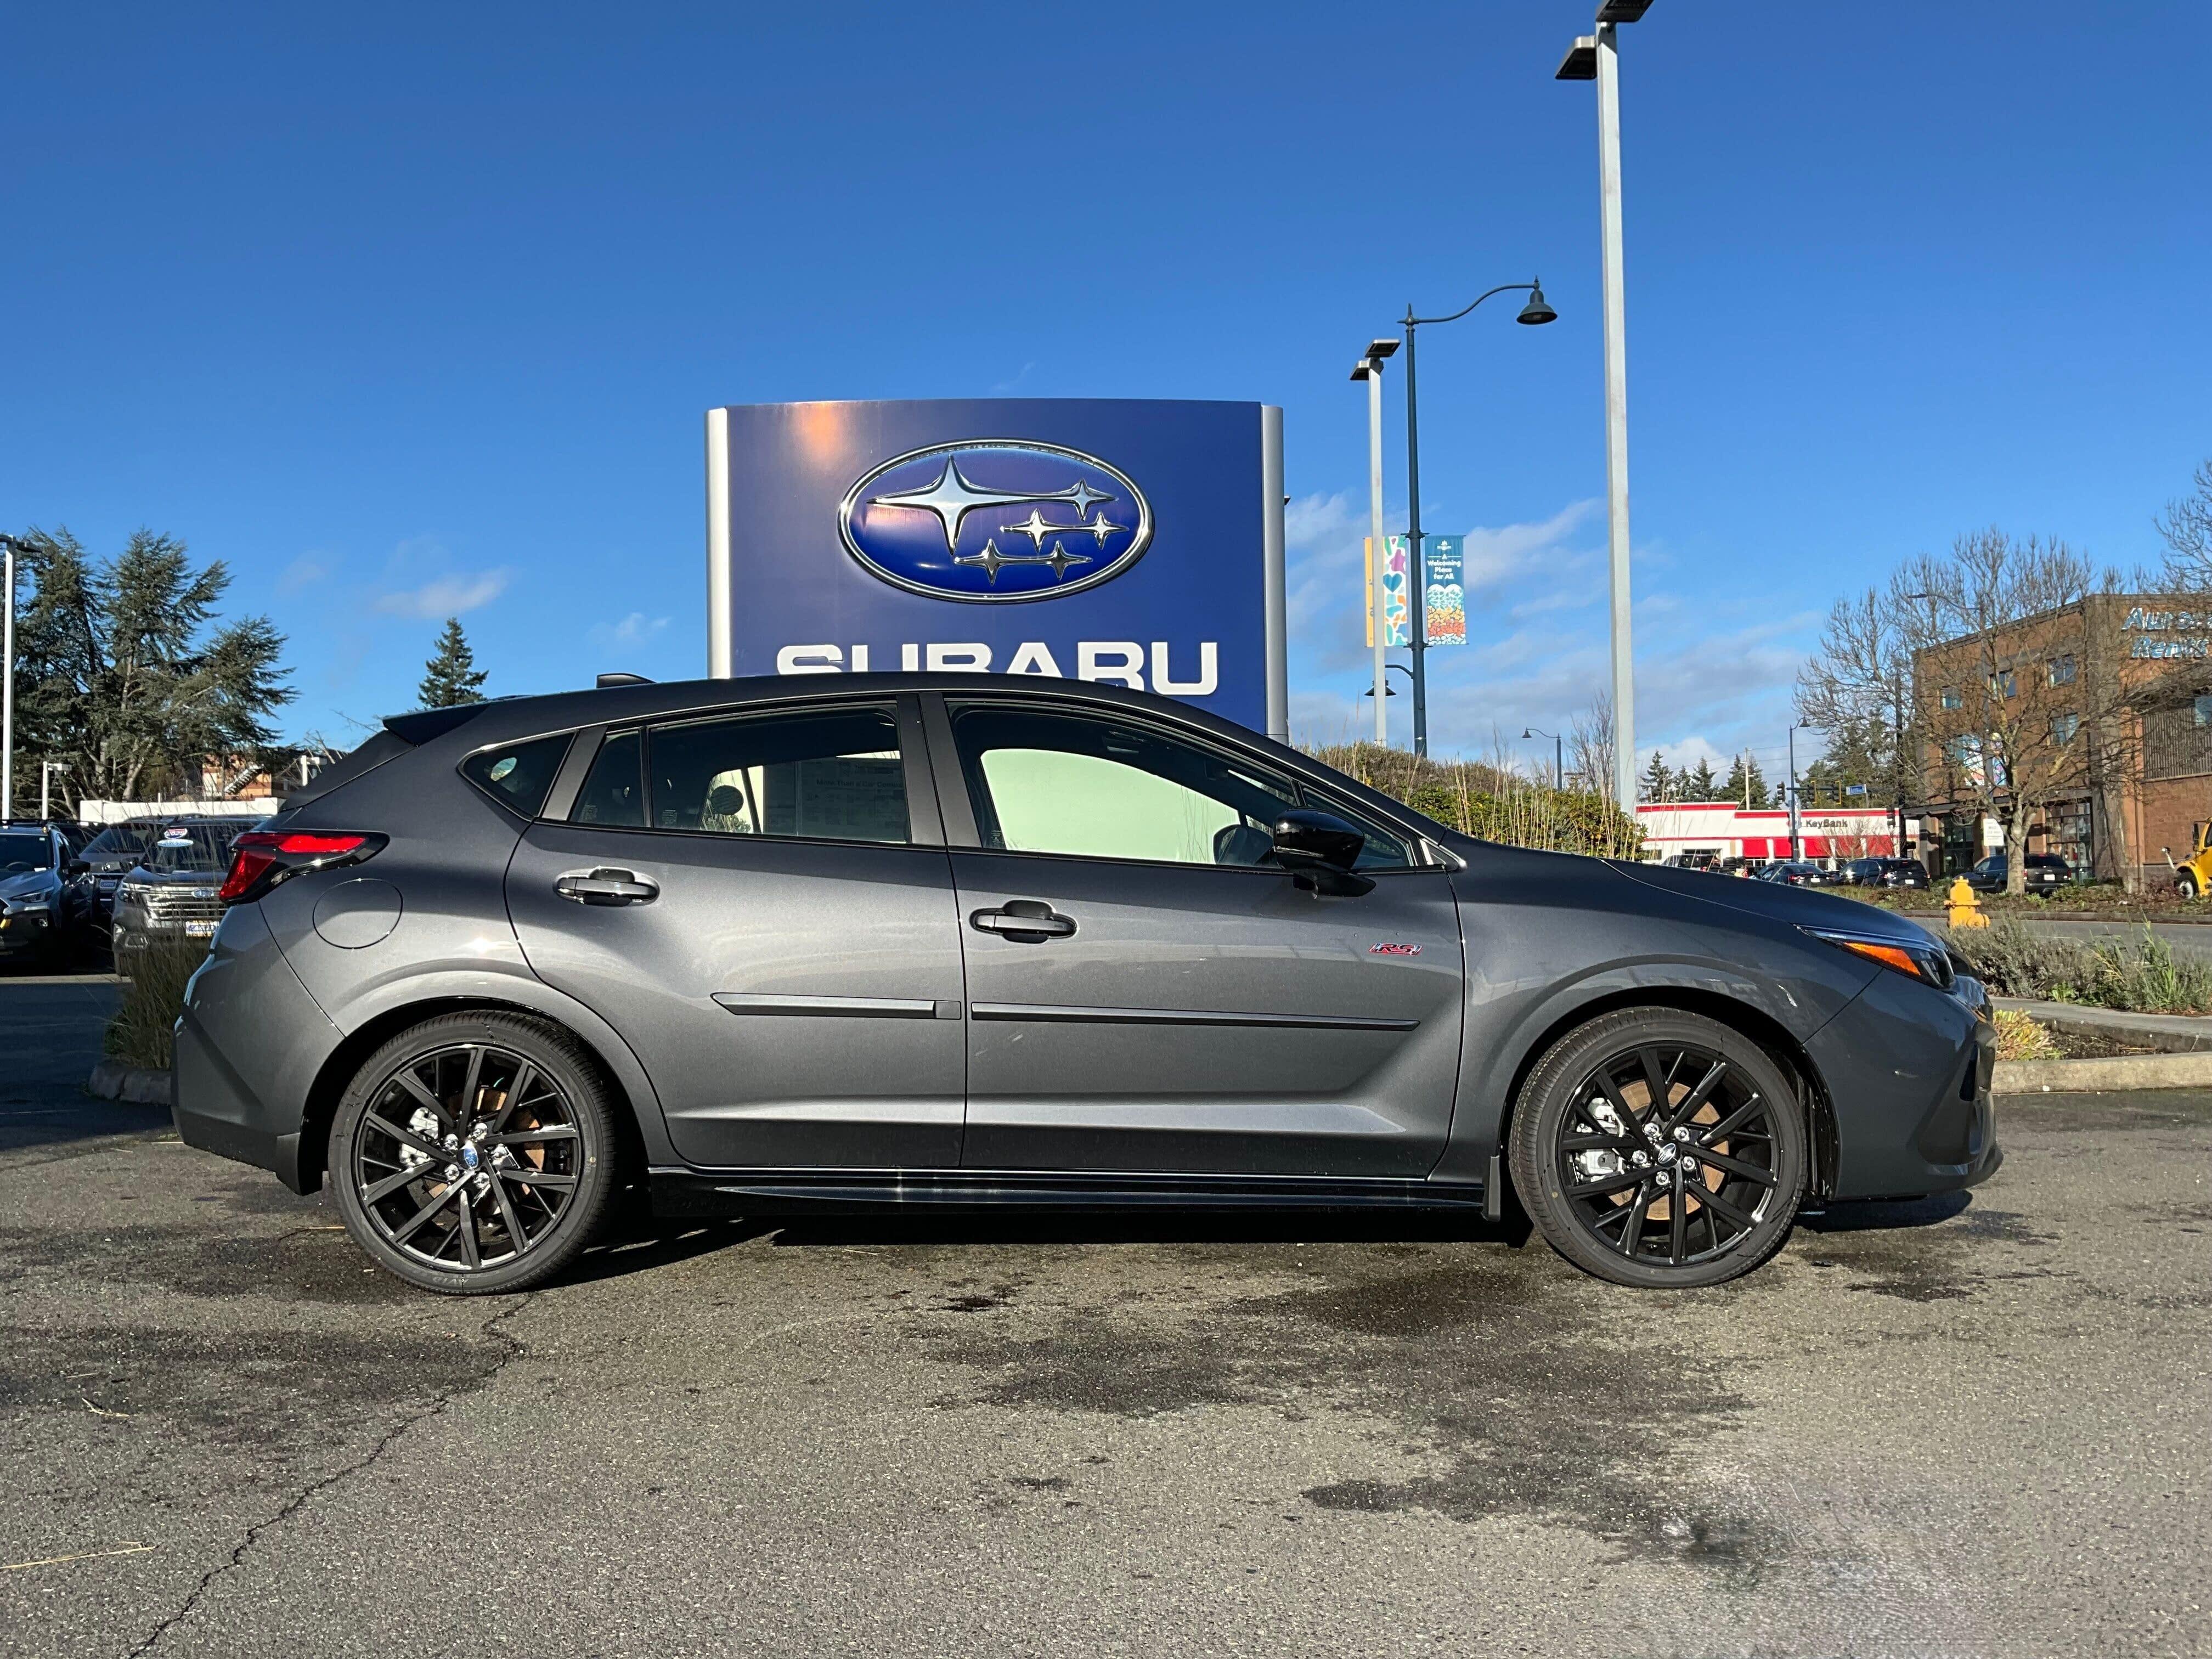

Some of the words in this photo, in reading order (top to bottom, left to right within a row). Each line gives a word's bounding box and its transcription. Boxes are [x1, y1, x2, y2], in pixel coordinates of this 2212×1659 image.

[777, 642, 1218, 696] SUBARU
[1806, 819, 1848, 829] KeyBank
[1378, 943, 1415, 953] RS
